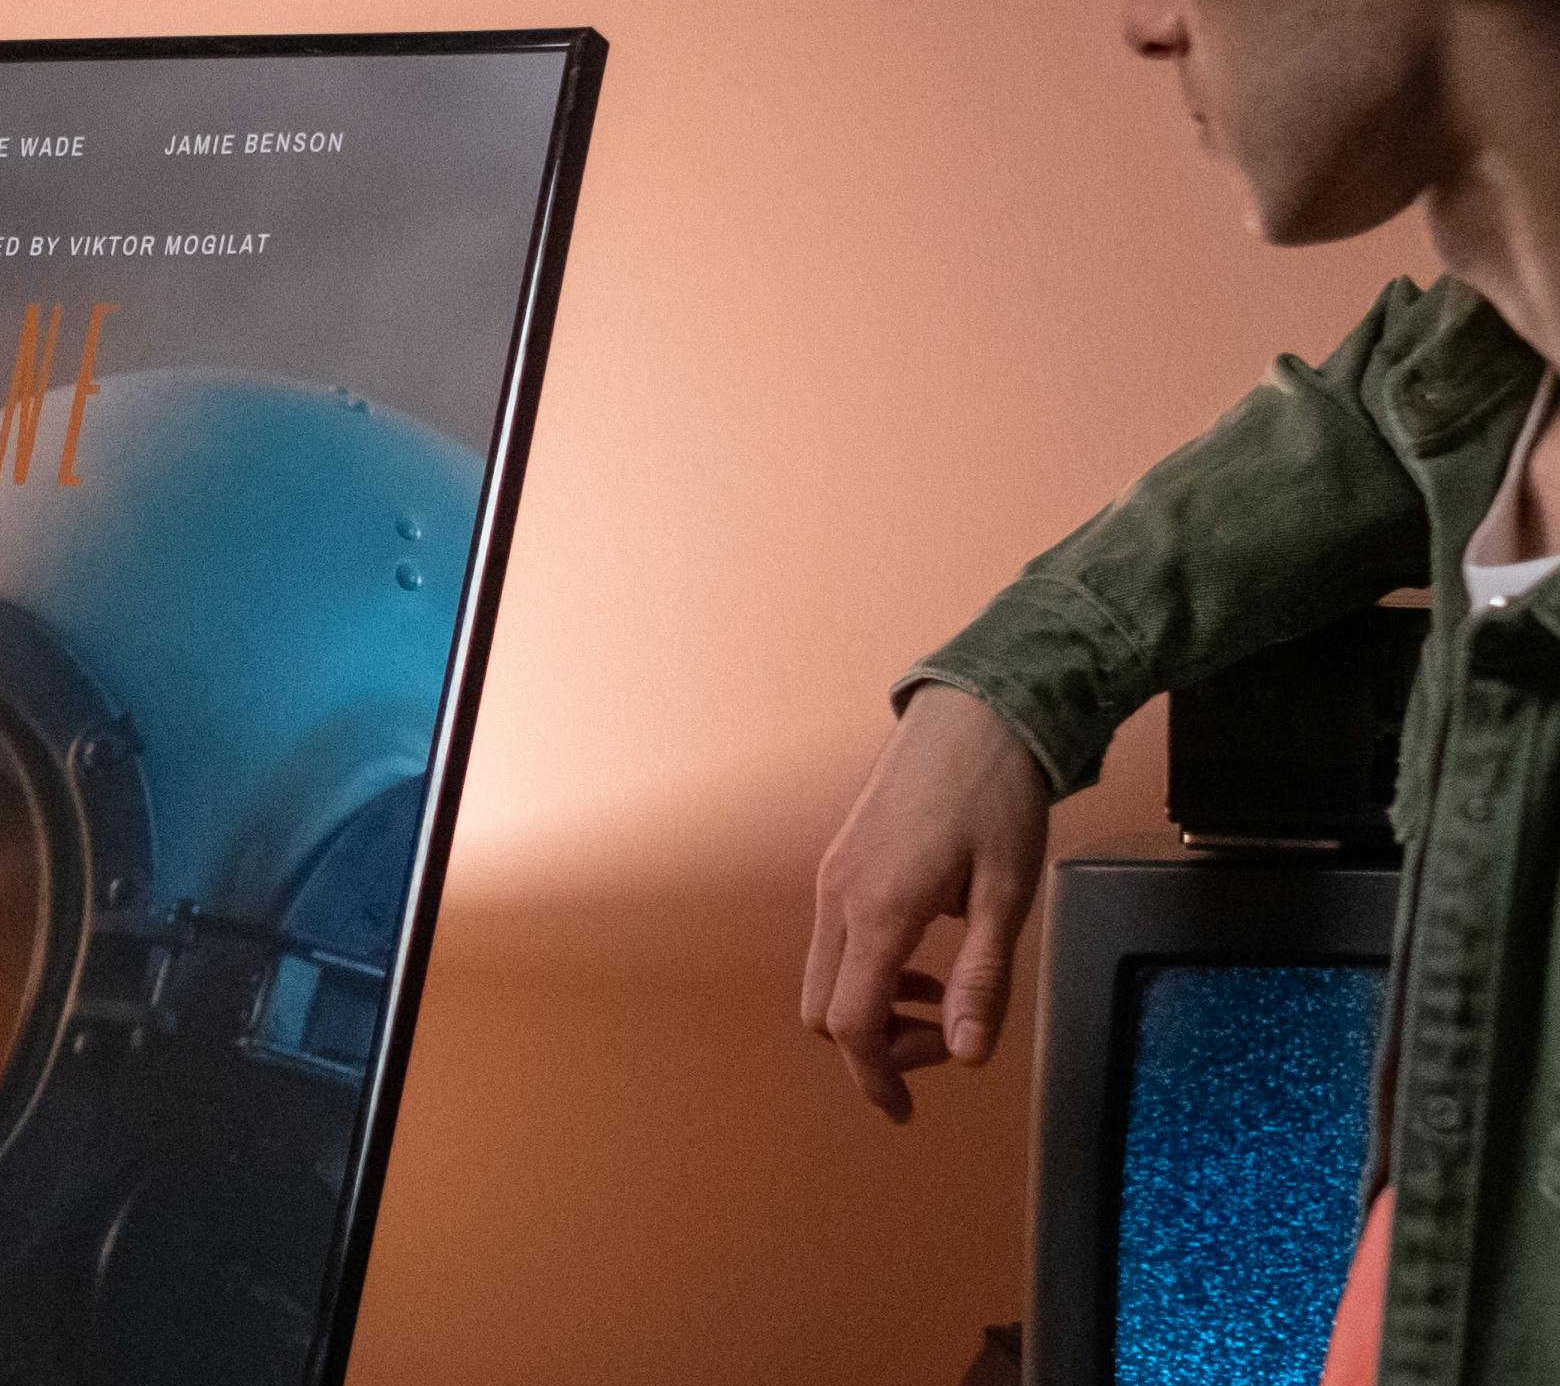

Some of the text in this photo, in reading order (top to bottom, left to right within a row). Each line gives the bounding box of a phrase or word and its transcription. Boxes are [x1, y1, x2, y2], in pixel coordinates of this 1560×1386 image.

[20, 135, 86, 157] WADE
[164, 131, 344, 156] JAMIE BENSON
[29, 235, 60, 257] BY
[70, 235, 155, 256] VIKTOR
[164, 233, 270, 256] MOGILAT
